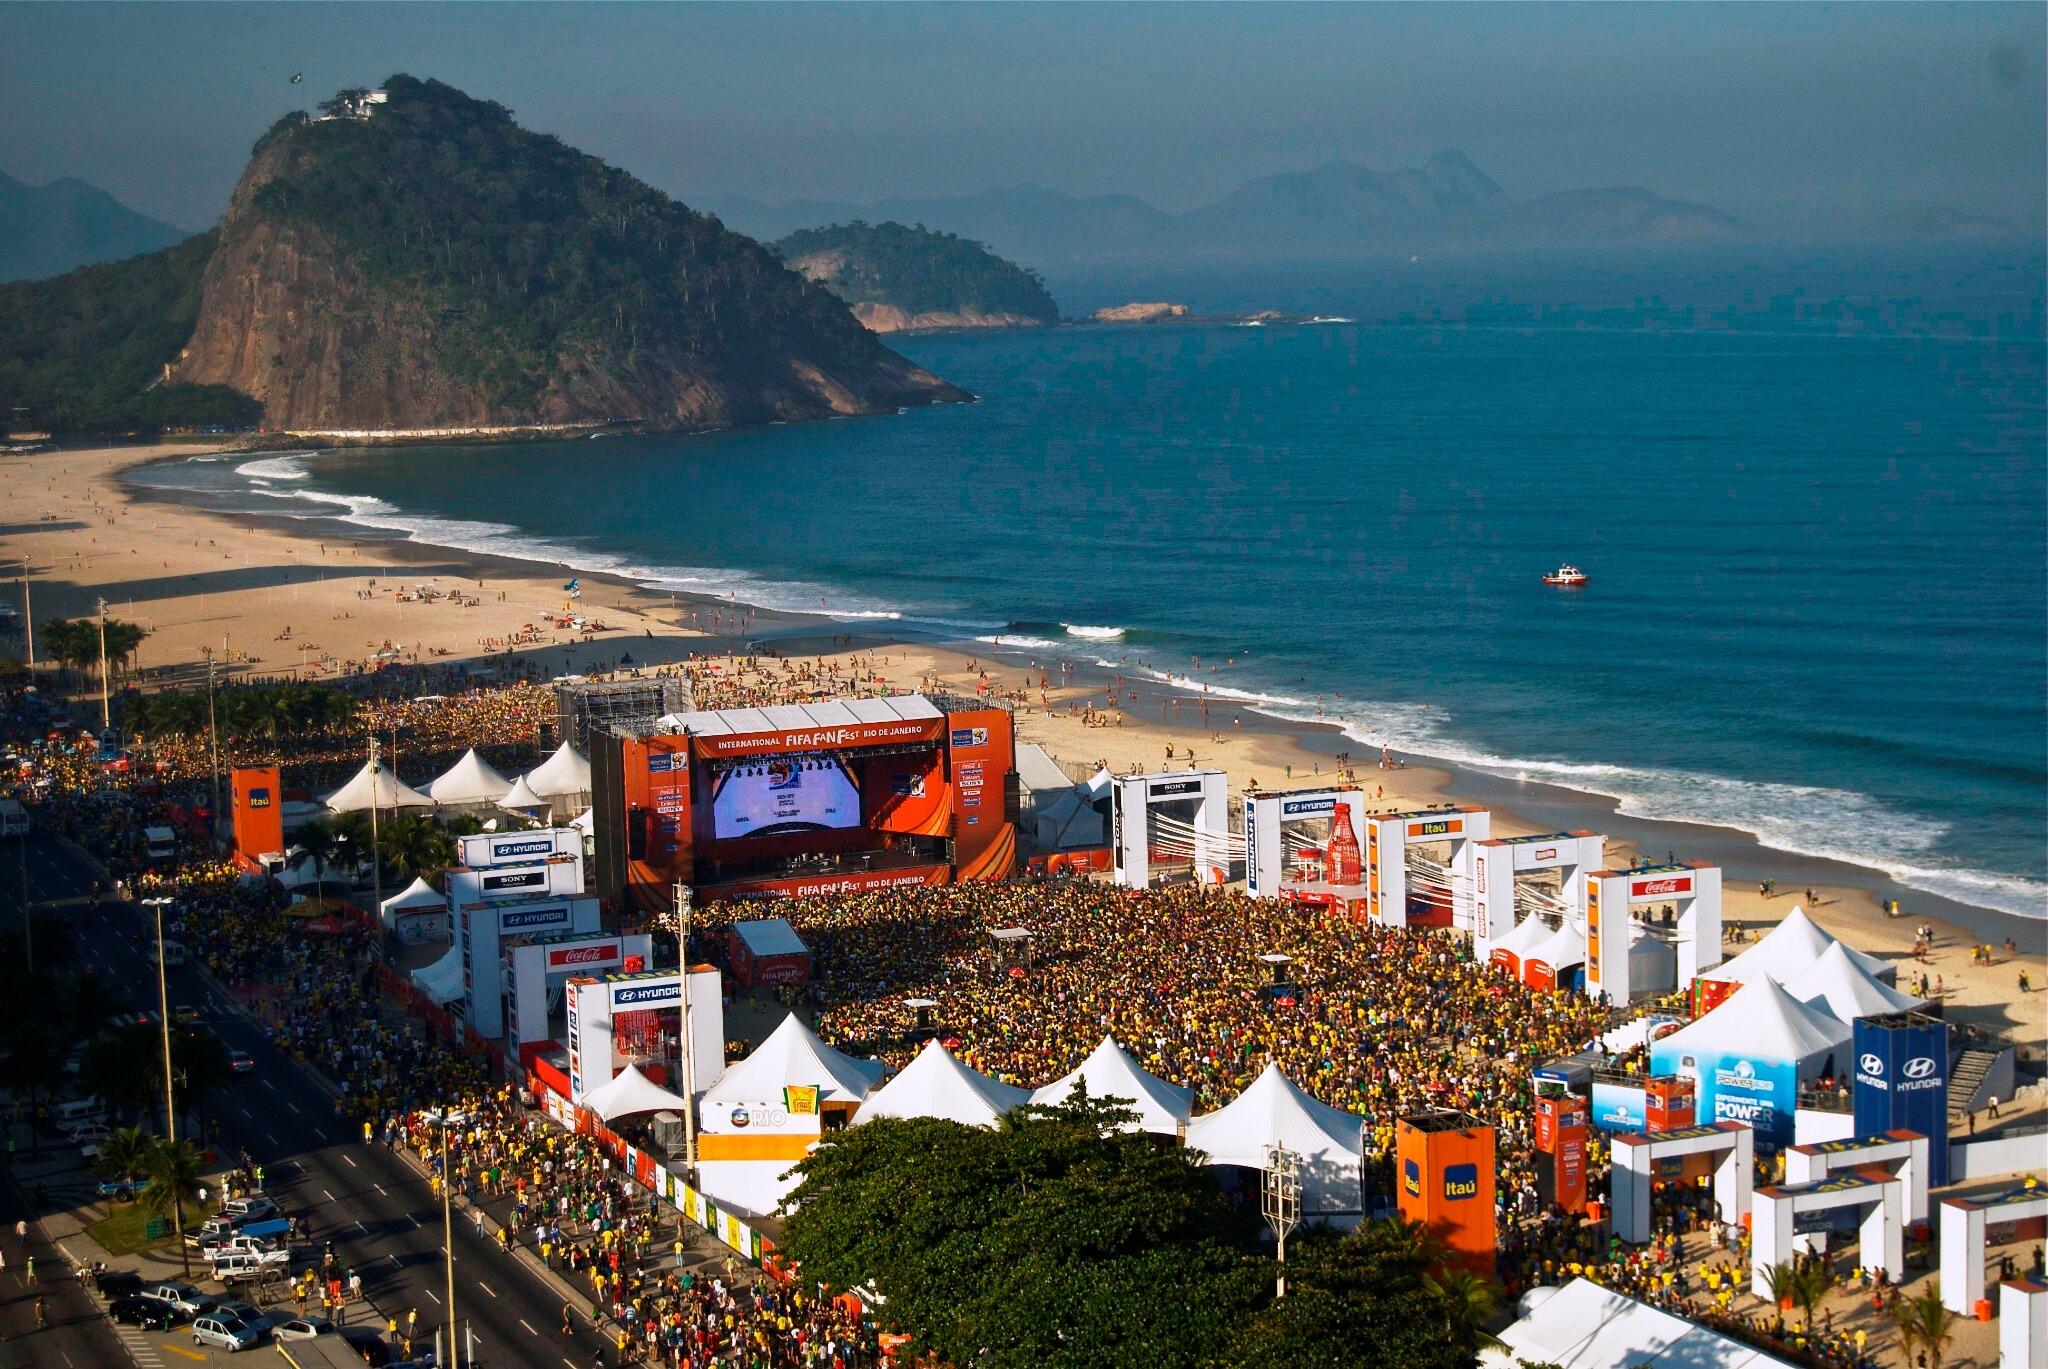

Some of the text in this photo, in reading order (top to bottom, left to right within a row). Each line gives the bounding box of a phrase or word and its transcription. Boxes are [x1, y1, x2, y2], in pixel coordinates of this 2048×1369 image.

[718, 725, 922, 749] INTERNATIONAL FIFA FAN FEST RIO DE JANEIRO
[250, 797, 269, 806] Itaú
[1301, 801, 1334, 811] HYUNDAI
[1424, 823, 1446, 834] Itaú
[513, 843, 549, 853] HYUNDAI
[1248, 822, 1256, 882] HYUNDAI
[501, 875, 527, 883] SONY
[797, 885, 820, 897] FIFA
[841, 880, 861, 893] FEST
[866, 880, 880, 889] RIO
[880, 878, 892, 888] DE
[892, 876, 925, 889] JANEIRO
[1644, 879, 1678, 895] Coca-Cola
[524, 911, 564, 923] HYUNDAI
[565, 947, 601, 963] Coca-Cola
[1856, 1072, 1888, 1091] HYUNDAI
[1896, 1077, 1942, 1092] HYUNDAI
[751, 1108, 787, 1128] RIO
[1714, 1101, 1775, 1122] POWER
[1445, 1179, 1476, 1196] Itaú
